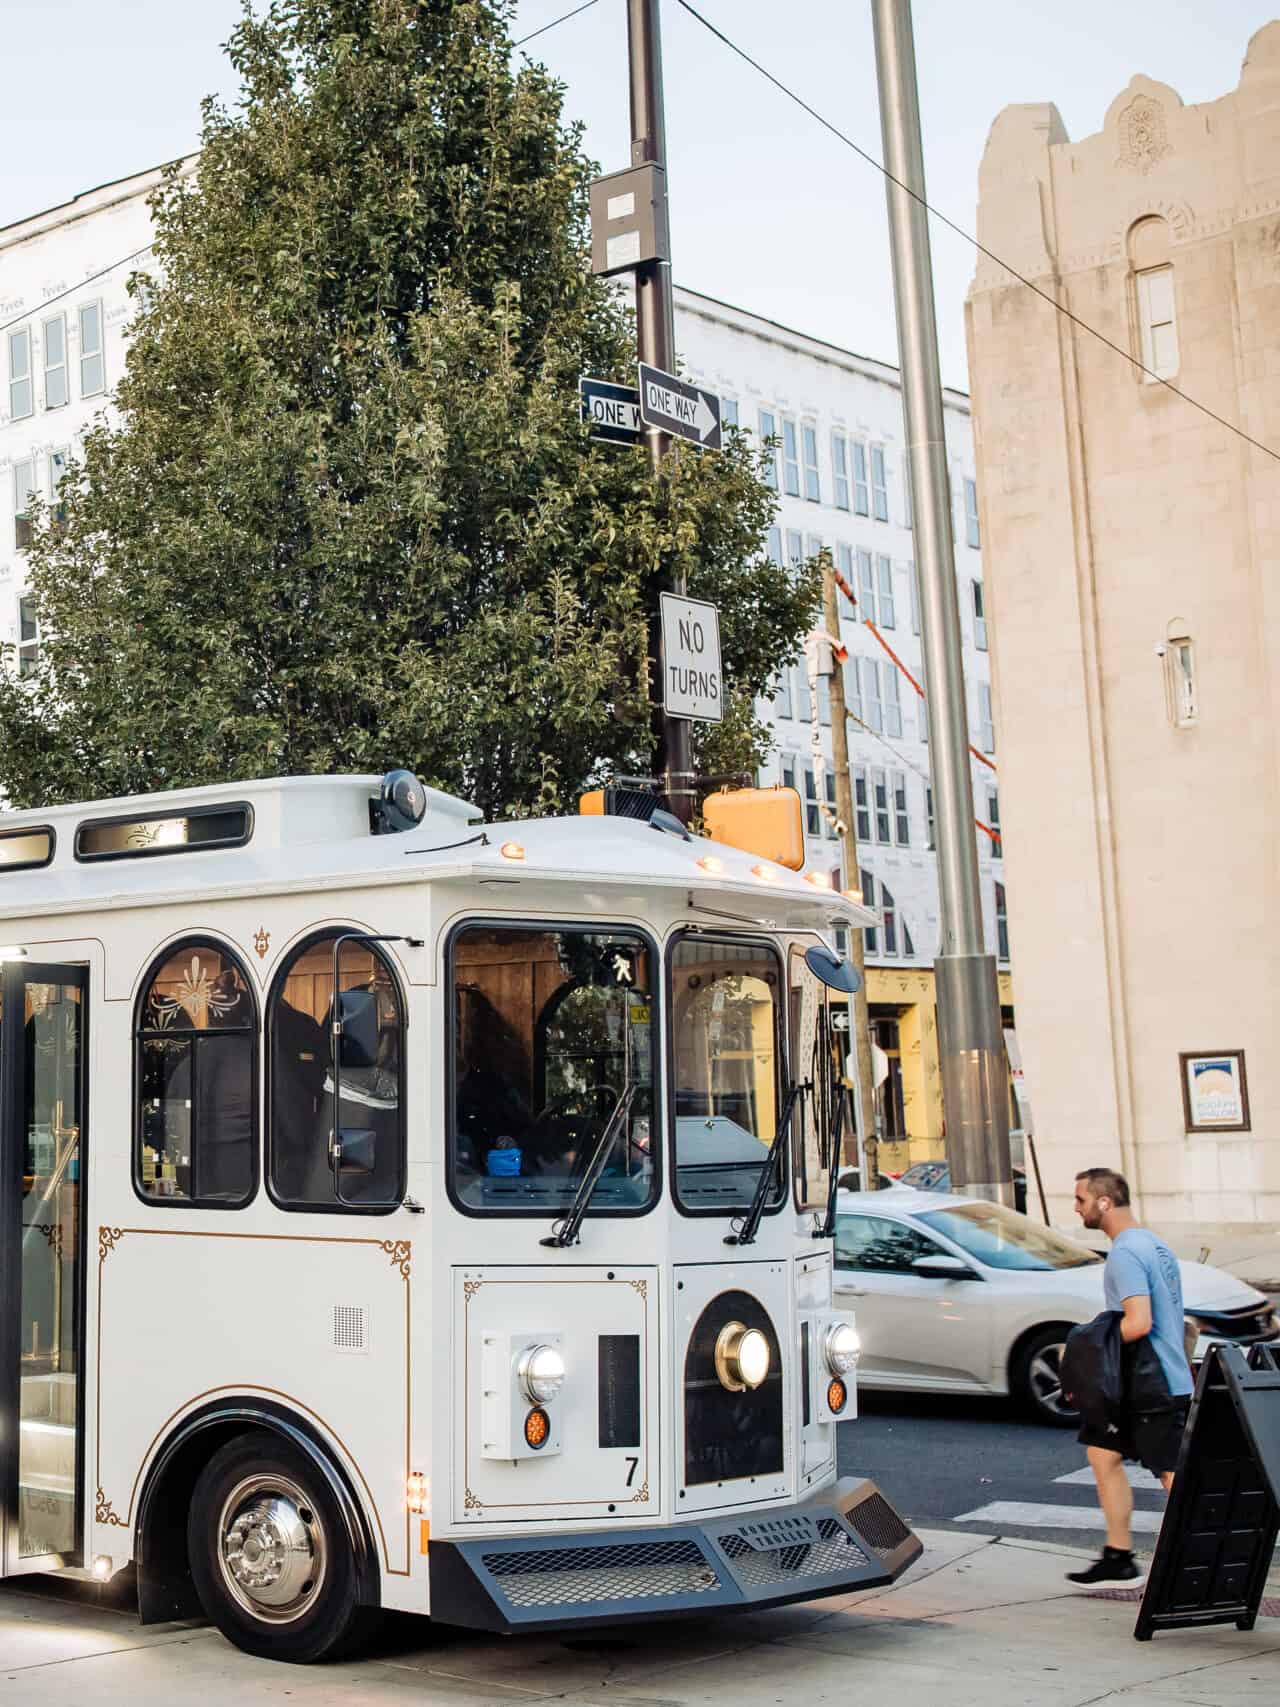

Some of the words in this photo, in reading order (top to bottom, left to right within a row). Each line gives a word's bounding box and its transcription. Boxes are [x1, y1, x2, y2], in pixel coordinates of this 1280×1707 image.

[594, 400, 626, 425] ONE
[649, 386, 671, 414] ONE
[674, 395, 697, 424] WAY
[679, 619, 704, 653] NO
[670, 666, 718, 699] TURNS
[625, 1456, 639, 1487] 7
